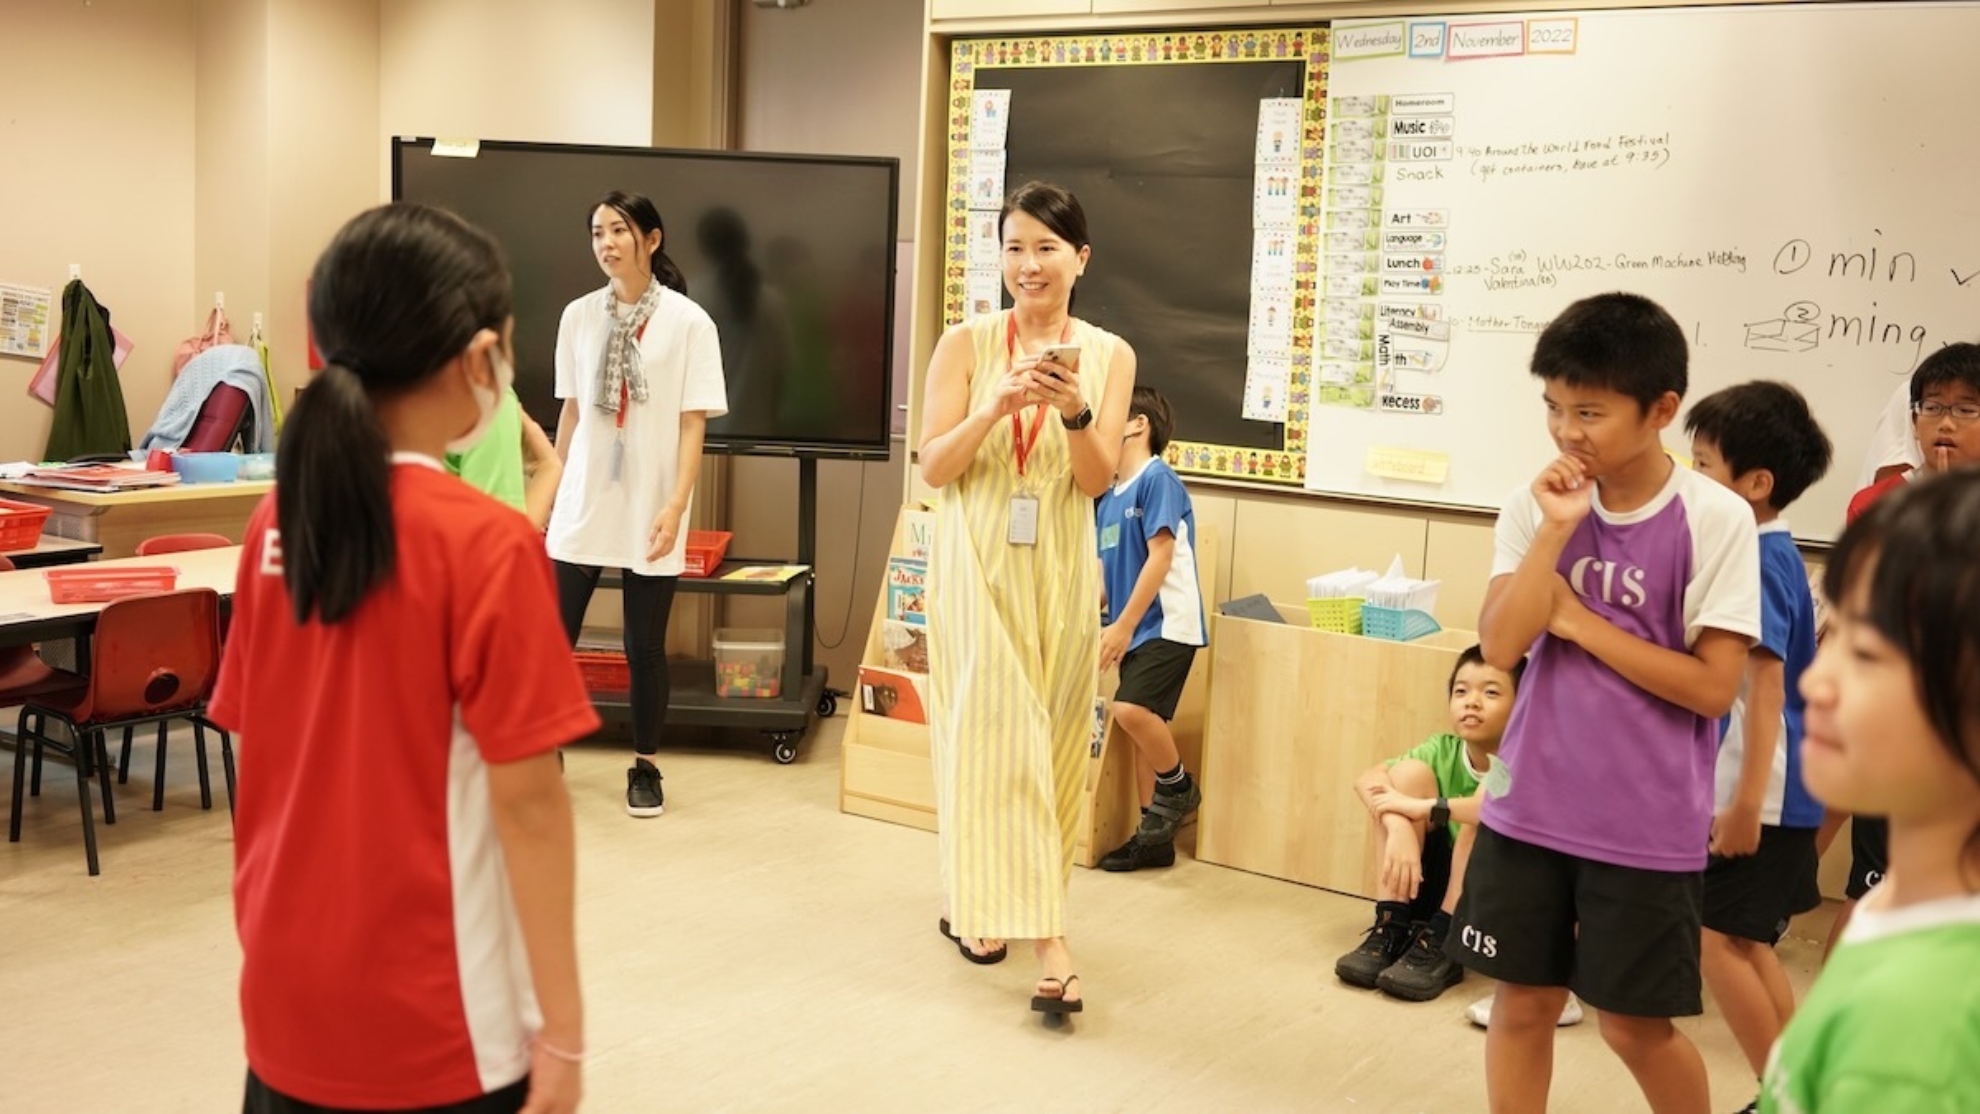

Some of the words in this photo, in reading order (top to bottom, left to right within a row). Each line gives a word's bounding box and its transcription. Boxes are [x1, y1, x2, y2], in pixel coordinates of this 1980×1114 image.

[1337, 30, 1402, 50] Wednesday
[1414, 30, 1440, 48] 2nd
[1452, 31, 1519, 49] November
[1531, 28, 1573, 43] 2022
[1395, 98, 1445, 107] Homeroom
[1394, 119, 1426, 135] Music
[1413, 146, 1437, 158] UOI
[1396, 165, 1445, 181] Snack
[1391, 213, 1412, 224] Art
[1385, 233, 1423, 245] Language
[1387, 257, 1421, 269] Lunch
[1829, 228, 1915, 282] min
[1388, 317, 1430, 336] Assembly
[1828, 301, 1926, 375] ming
[1378, 334, 1391, 366] Math
[1570, 556, 1647, 607] CIS
[1461, 924, 1498, 958] CIS
